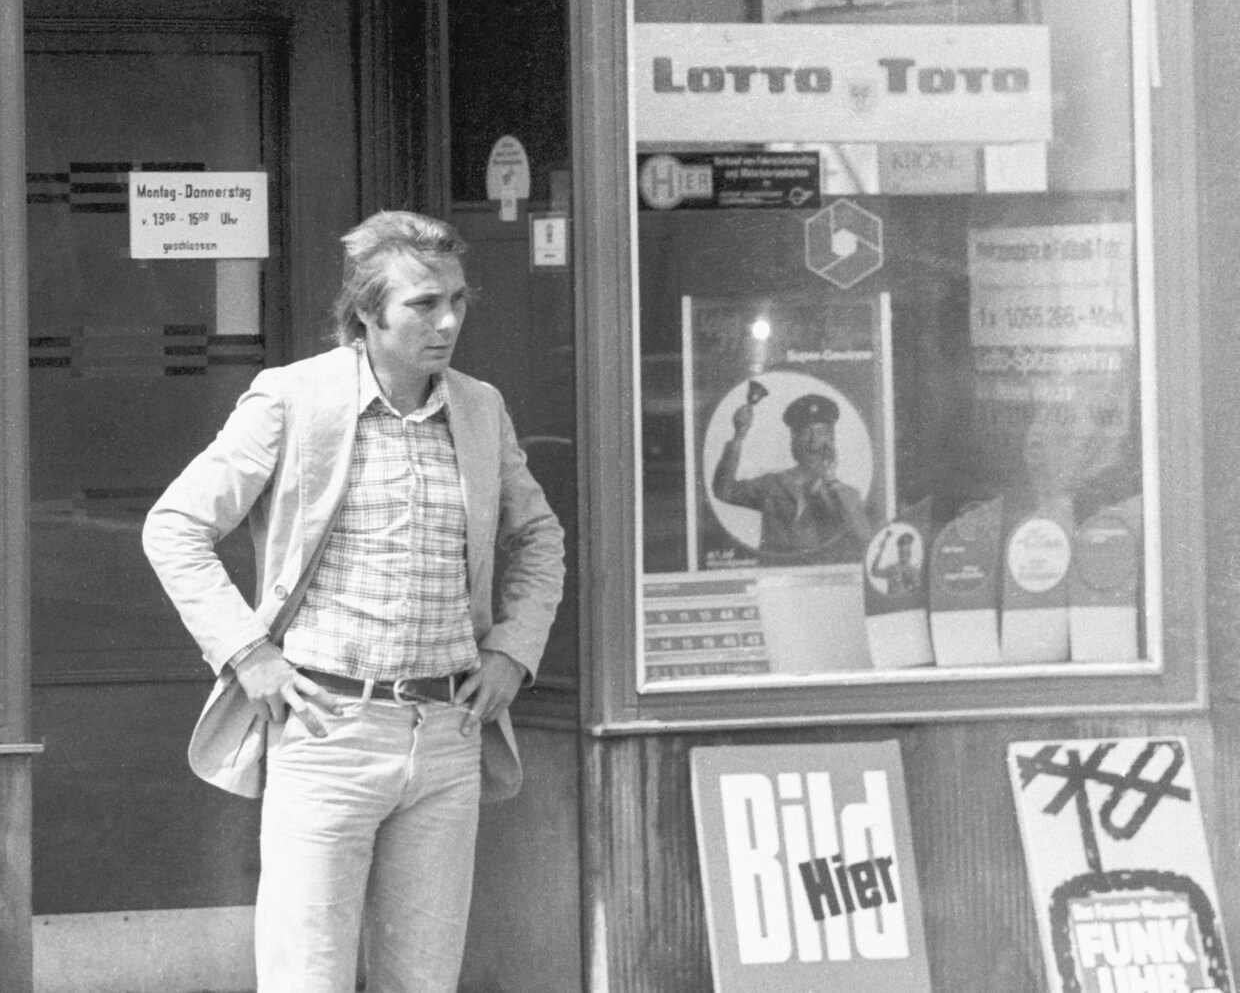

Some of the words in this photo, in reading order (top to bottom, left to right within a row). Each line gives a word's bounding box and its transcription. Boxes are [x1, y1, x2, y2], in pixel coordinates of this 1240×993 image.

[136, 184, 177, 201] Montag
[184, 184, 252, 201] Donnerstag
[220, 212, 239, 226] Uhr
[798, 853, 898, 922] Hier
[1075, 919, 1198, 968] FUNK
